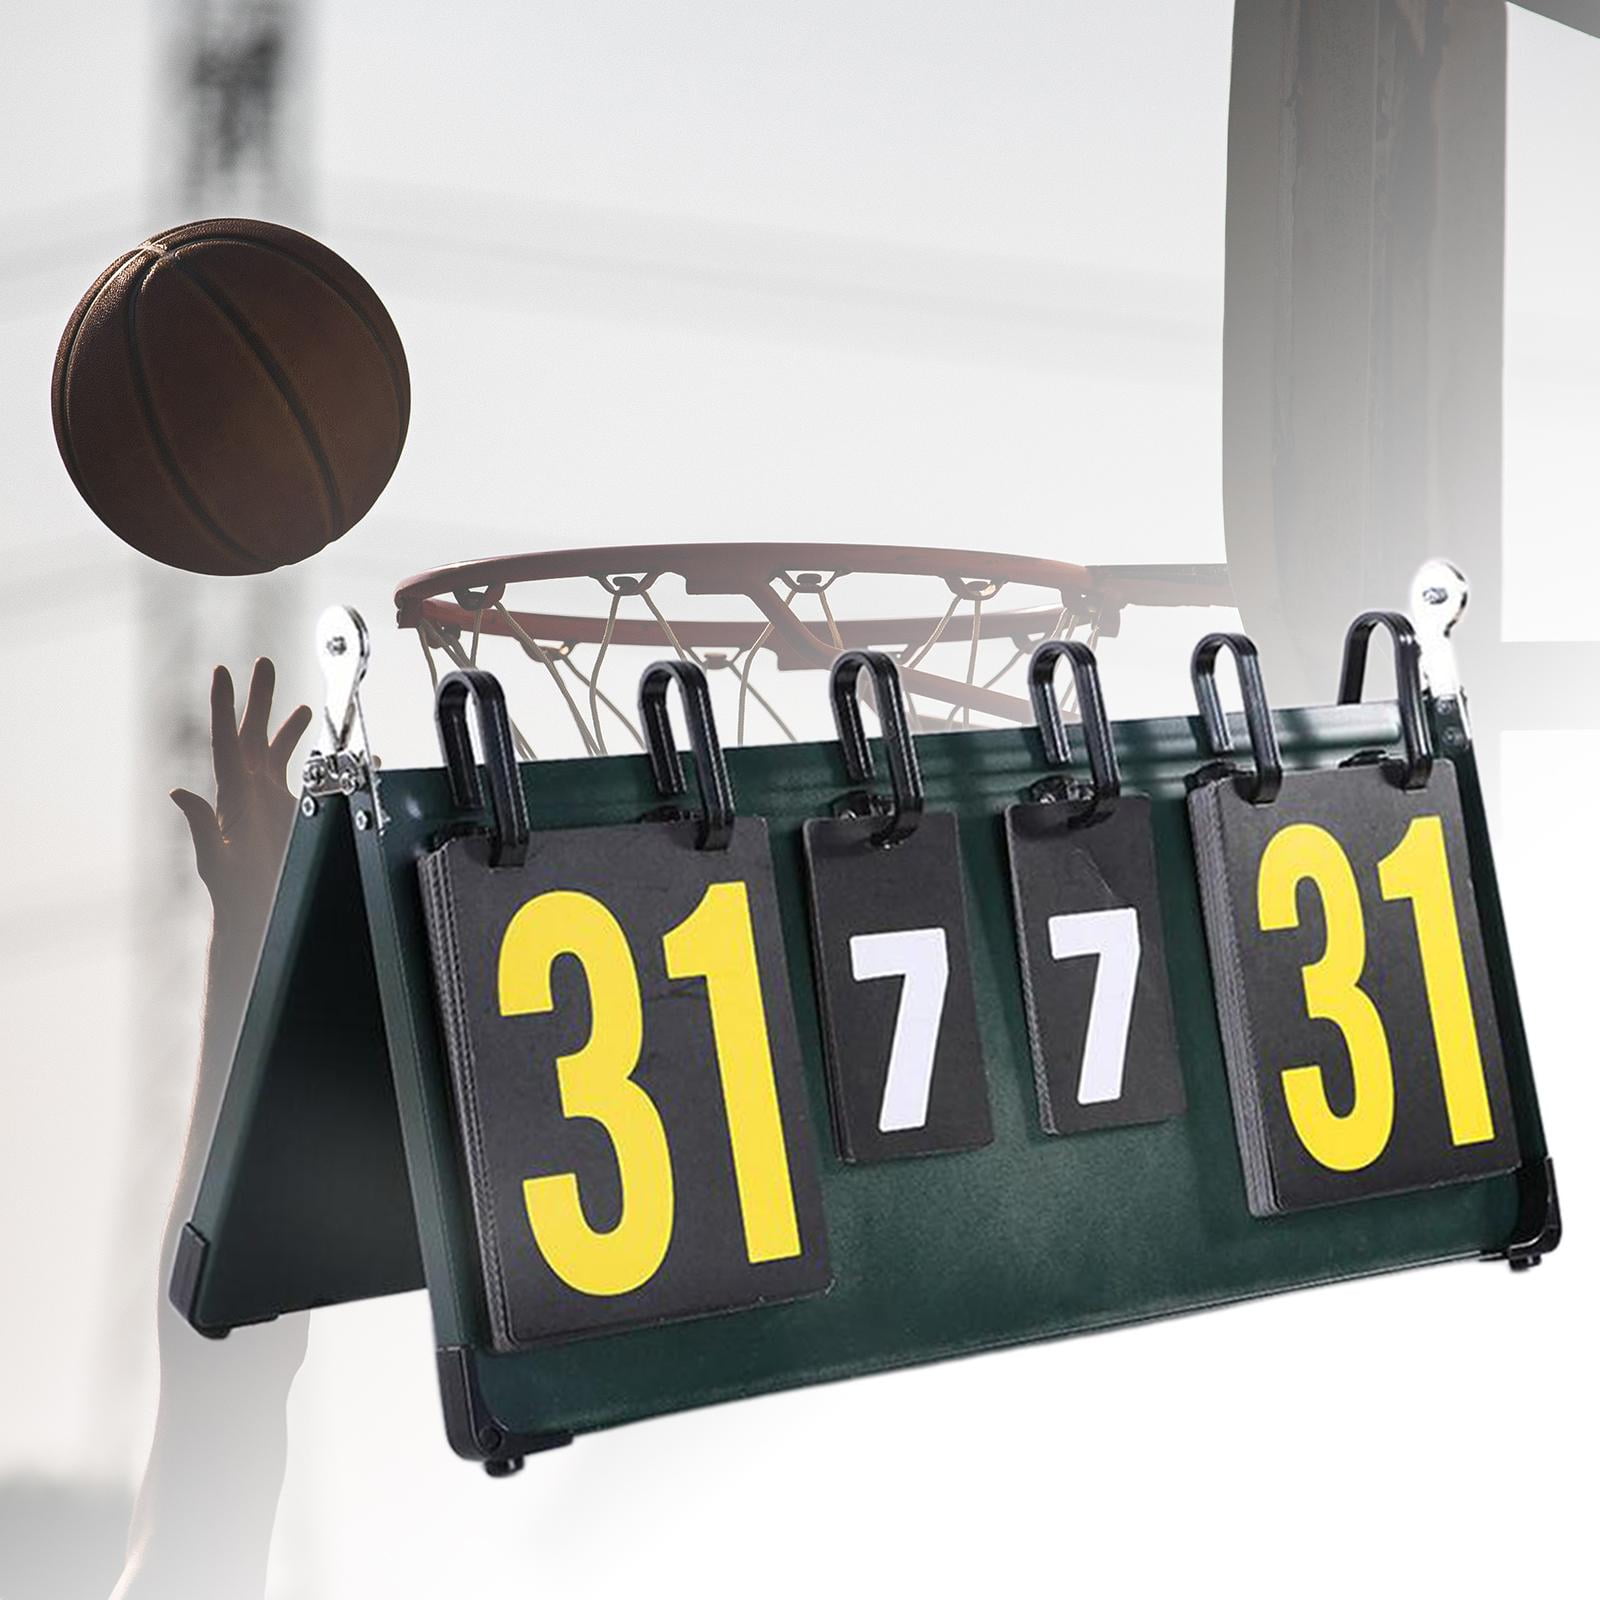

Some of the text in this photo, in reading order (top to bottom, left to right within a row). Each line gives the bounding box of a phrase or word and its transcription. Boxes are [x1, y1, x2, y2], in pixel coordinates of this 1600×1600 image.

[498, 881, 802, 1297] 31
[849, 928, 950, 1132] 7
[1048, 908, 1141, 1104] 7
[1257, 816, 1495, 1172] 31
